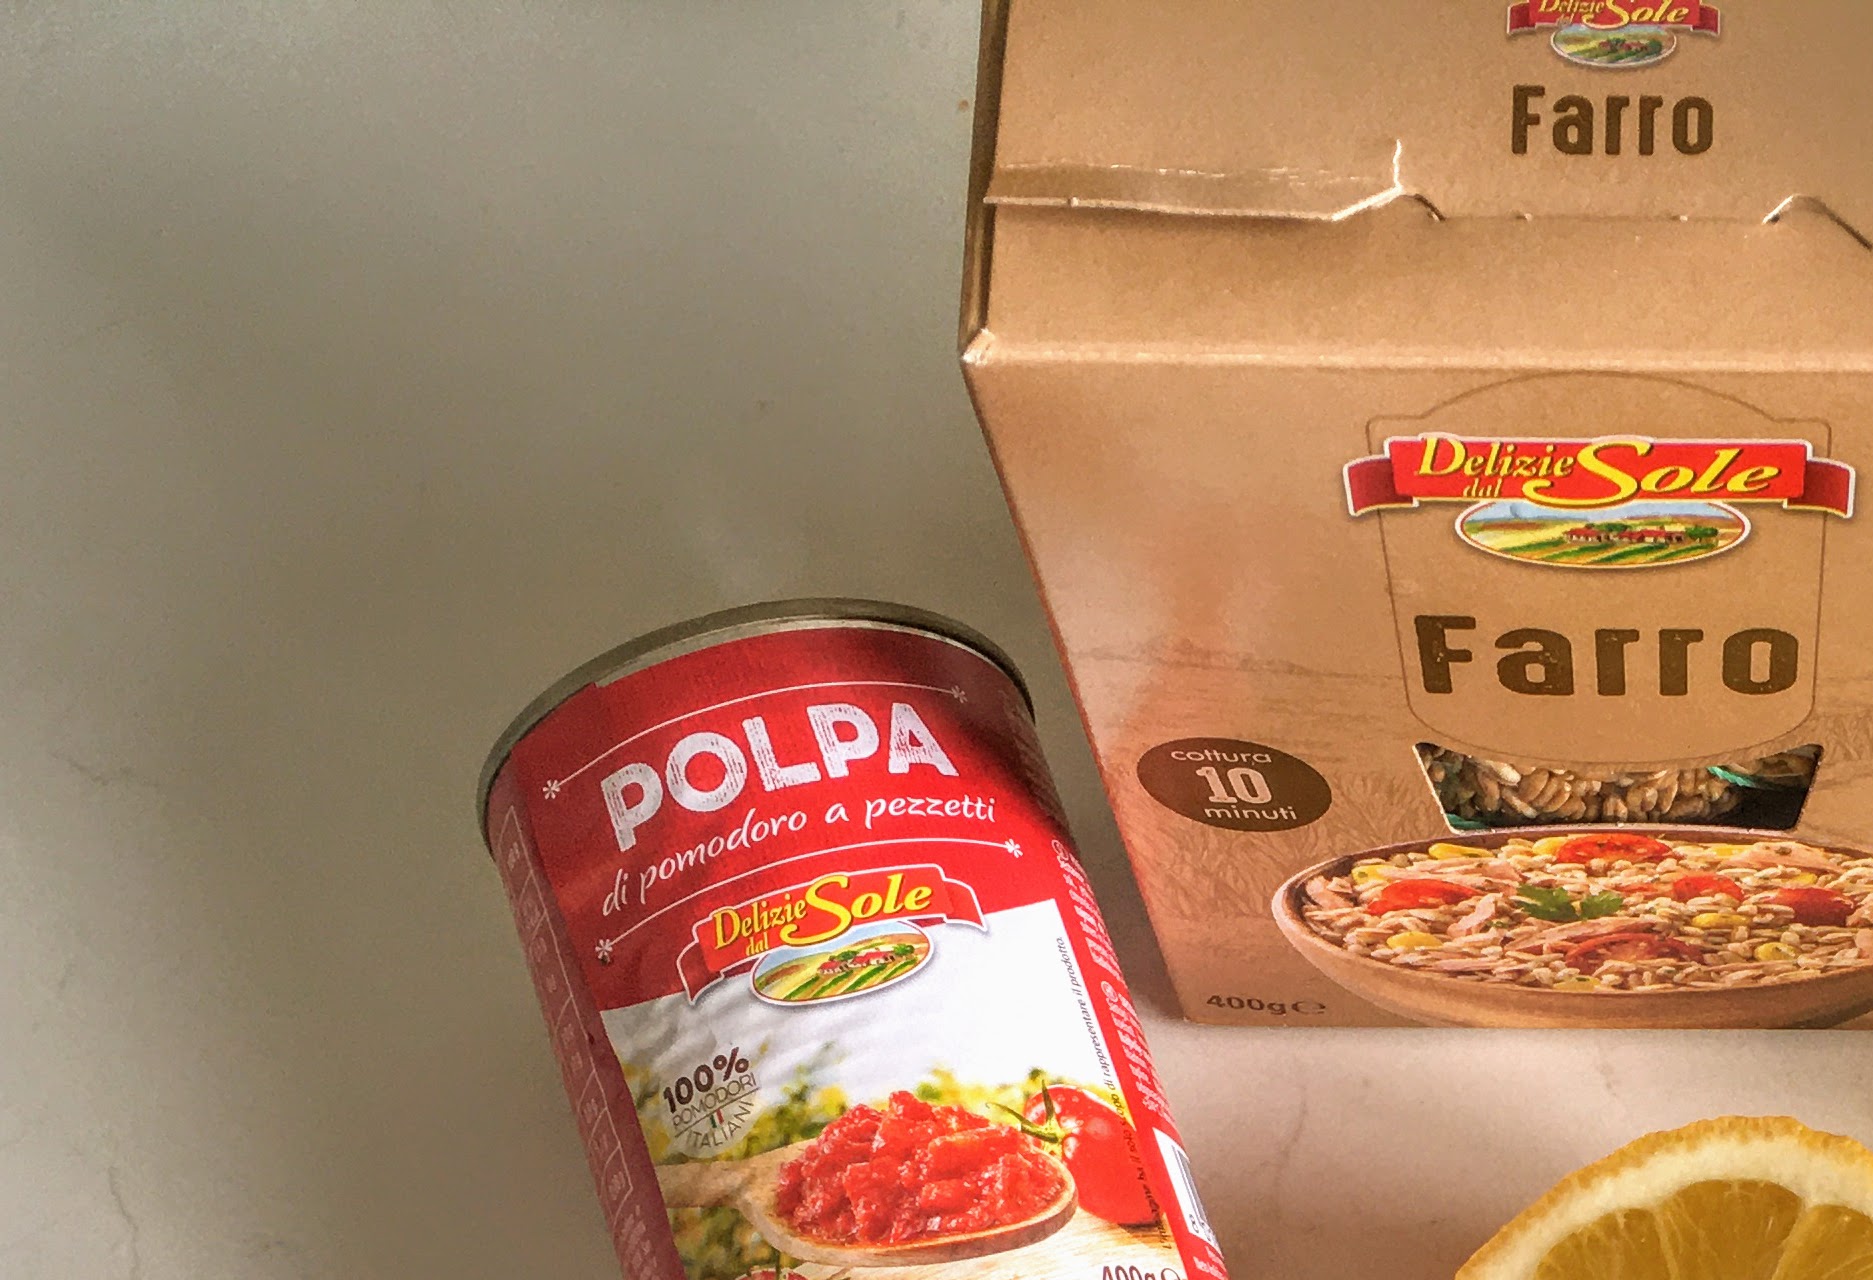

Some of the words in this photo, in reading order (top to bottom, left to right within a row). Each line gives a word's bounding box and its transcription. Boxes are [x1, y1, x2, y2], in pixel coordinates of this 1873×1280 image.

[1582, 0, 1689, 29] Sole
[1511, 84, 1715, 156] Farro
[1414, 437, 1575, 479] Delizie
[1522, 440, 1782, 508] Sole
[1463, 477, 1503, 499] dal
[1414, 615, 1799, 697] Farro
[600, 702, 960, 852] POLPA
[1170, 748, 1272, 765] cottura
[1195, 765, 1273, 805] 10
[1204, 805, 1298, 822] minuti
[602, 868, 630, 917] di
[638, 808, 807, 905] pomodoro
[825, 803, 848, 824] a
[865, 794, 996, 829] pezzetti
[713, 894, 807, 950] Delizie
[779, 873, 933, 947] Sole
[745, 932, 769, 956] dal
[1206, 995, 1287, 1015] 400g
[1077, 999, 1111, 1077] rappresentare
[663, 1046, 750, 1114] 100%
[672, 1072, 757, 1130] POMODORI
[686, 1100, 754, 1148] ITALIANI
